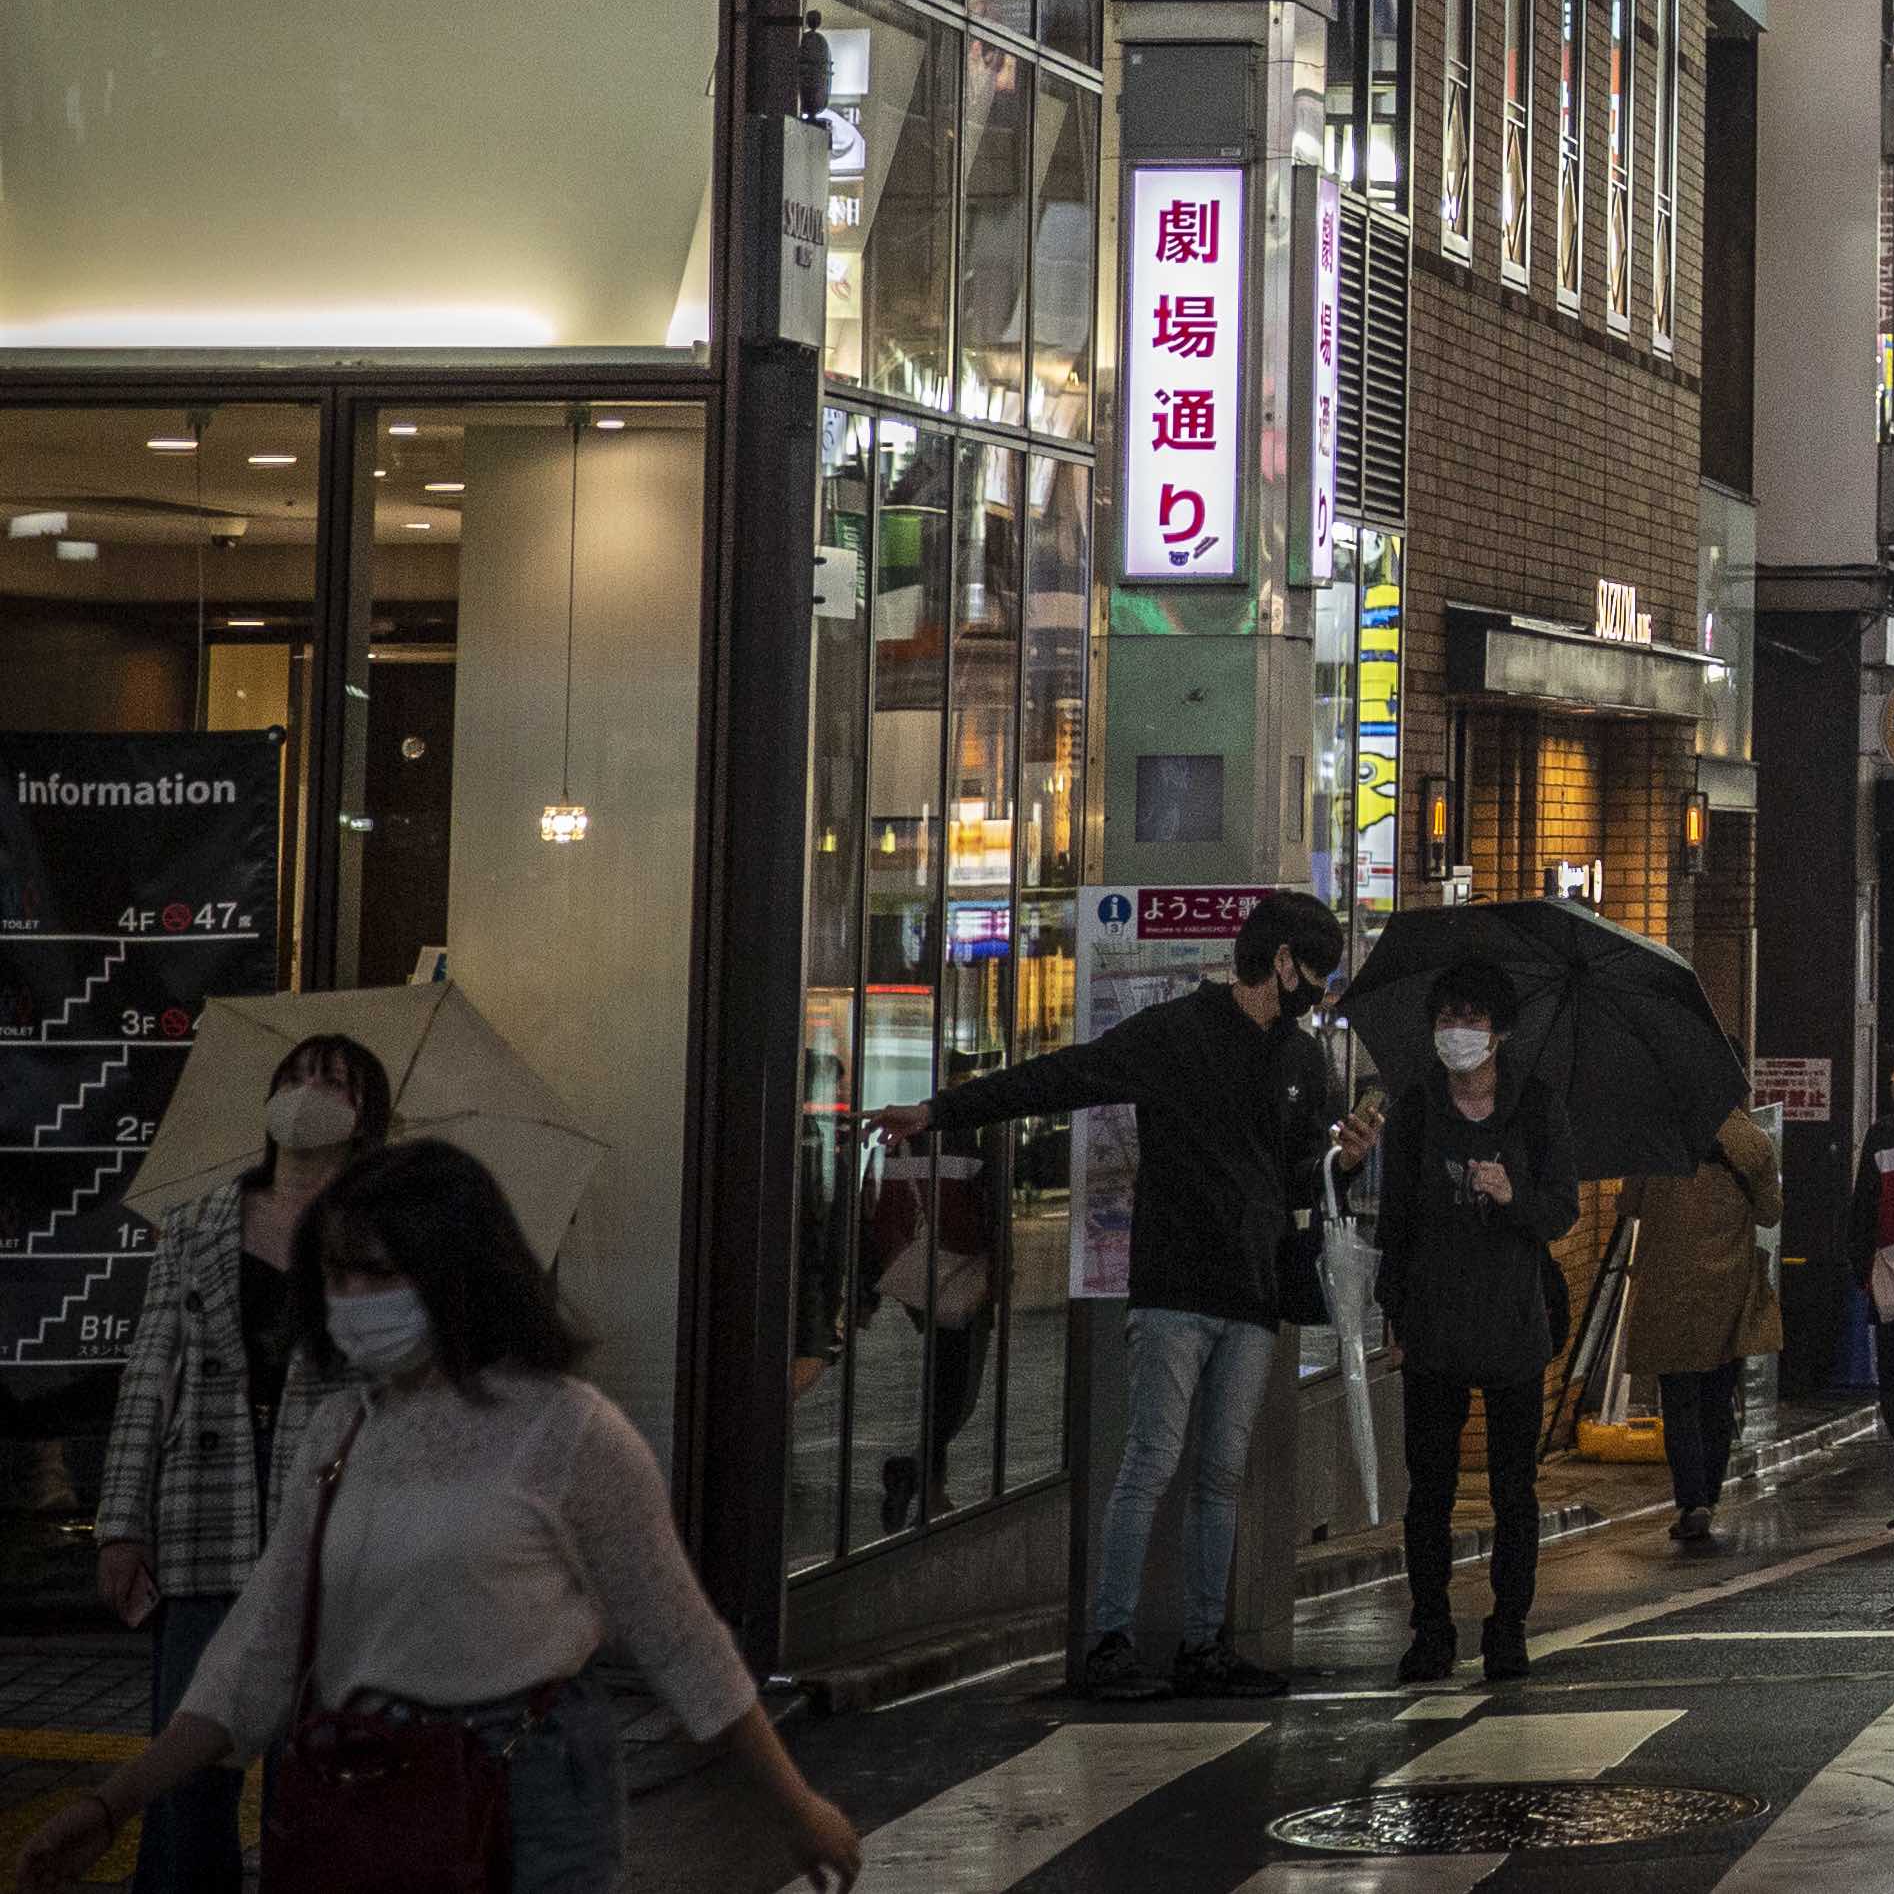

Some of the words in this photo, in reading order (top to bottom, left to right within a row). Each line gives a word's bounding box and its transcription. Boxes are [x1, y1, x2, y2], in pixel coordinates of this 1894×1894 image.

[1152, 199, 1221, 544] 劇場通り
[19, 773, 236, 805] information
[118, 908, 155, 932] 4F
[121, 1010, 155, 1035] 3F
[116, 1116, 155, 1142] 2F
[118, 1224, 147, 1248] 1F
[80, 1315, 130, 1341] B1F
